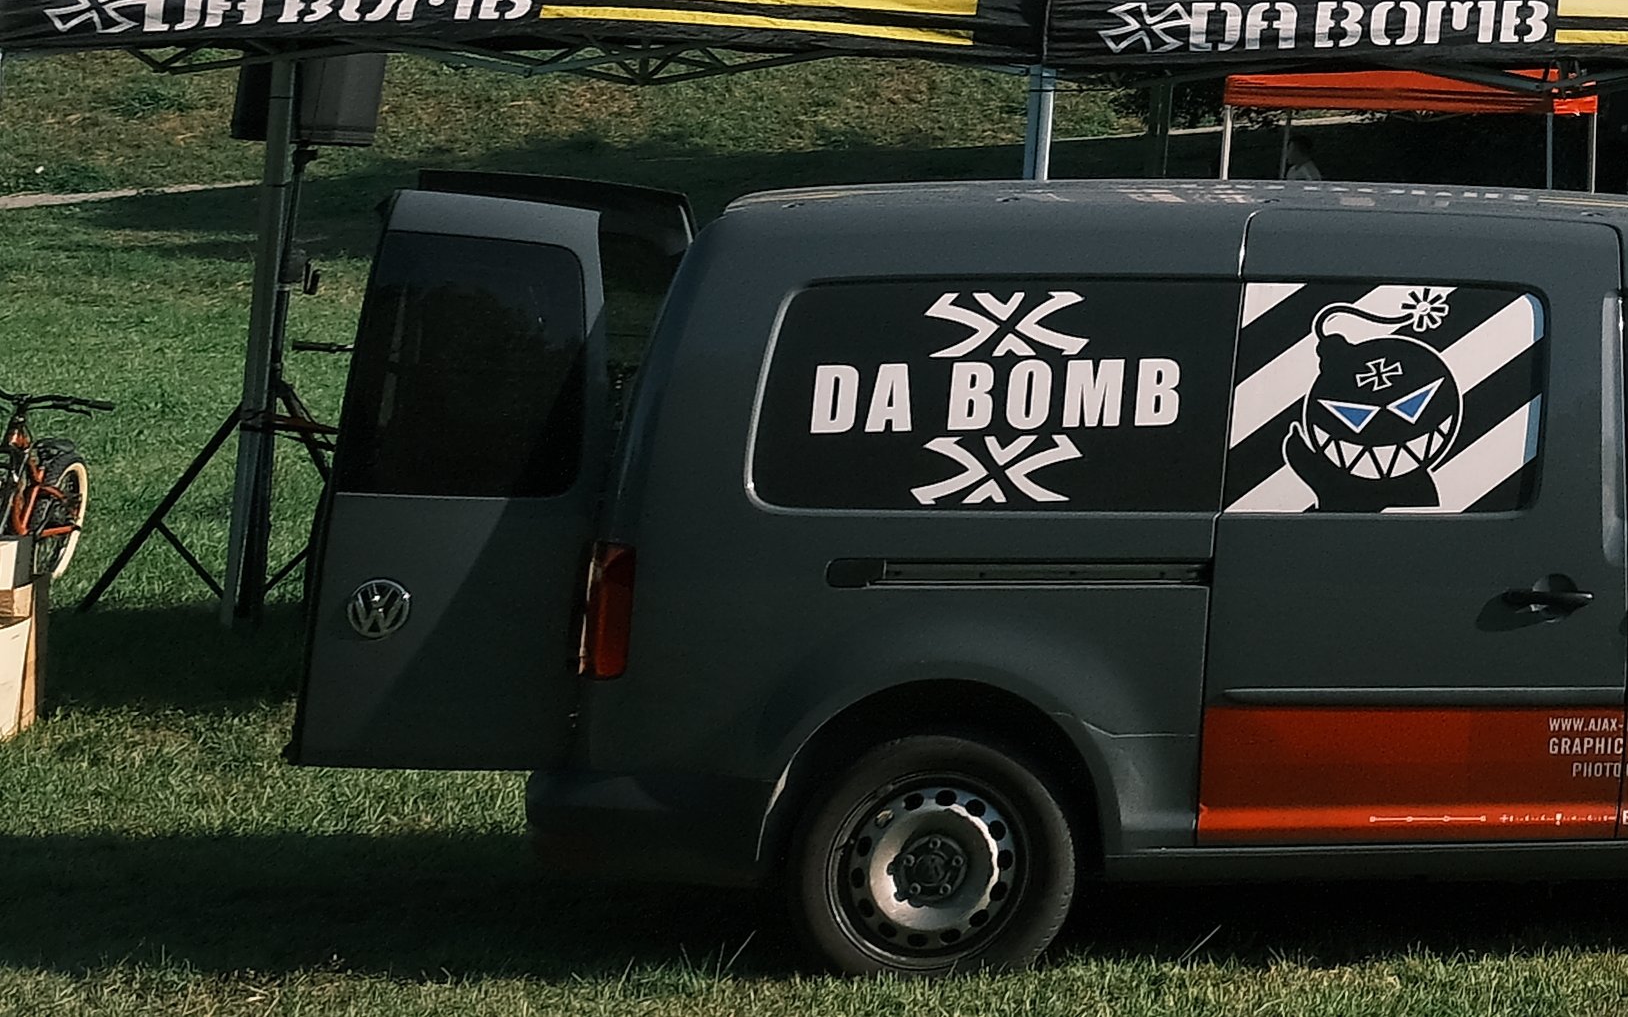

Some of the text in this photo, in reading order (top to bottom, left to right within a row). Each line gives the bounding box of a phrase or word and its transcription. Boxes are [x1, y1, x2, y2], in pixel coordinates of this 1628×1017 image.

[1188, 0, 1550, 52] DA BOMB
[810, 358, 1182, 434] DA BOMB
[1549, 737, 1624, 755] GRAPHIC
